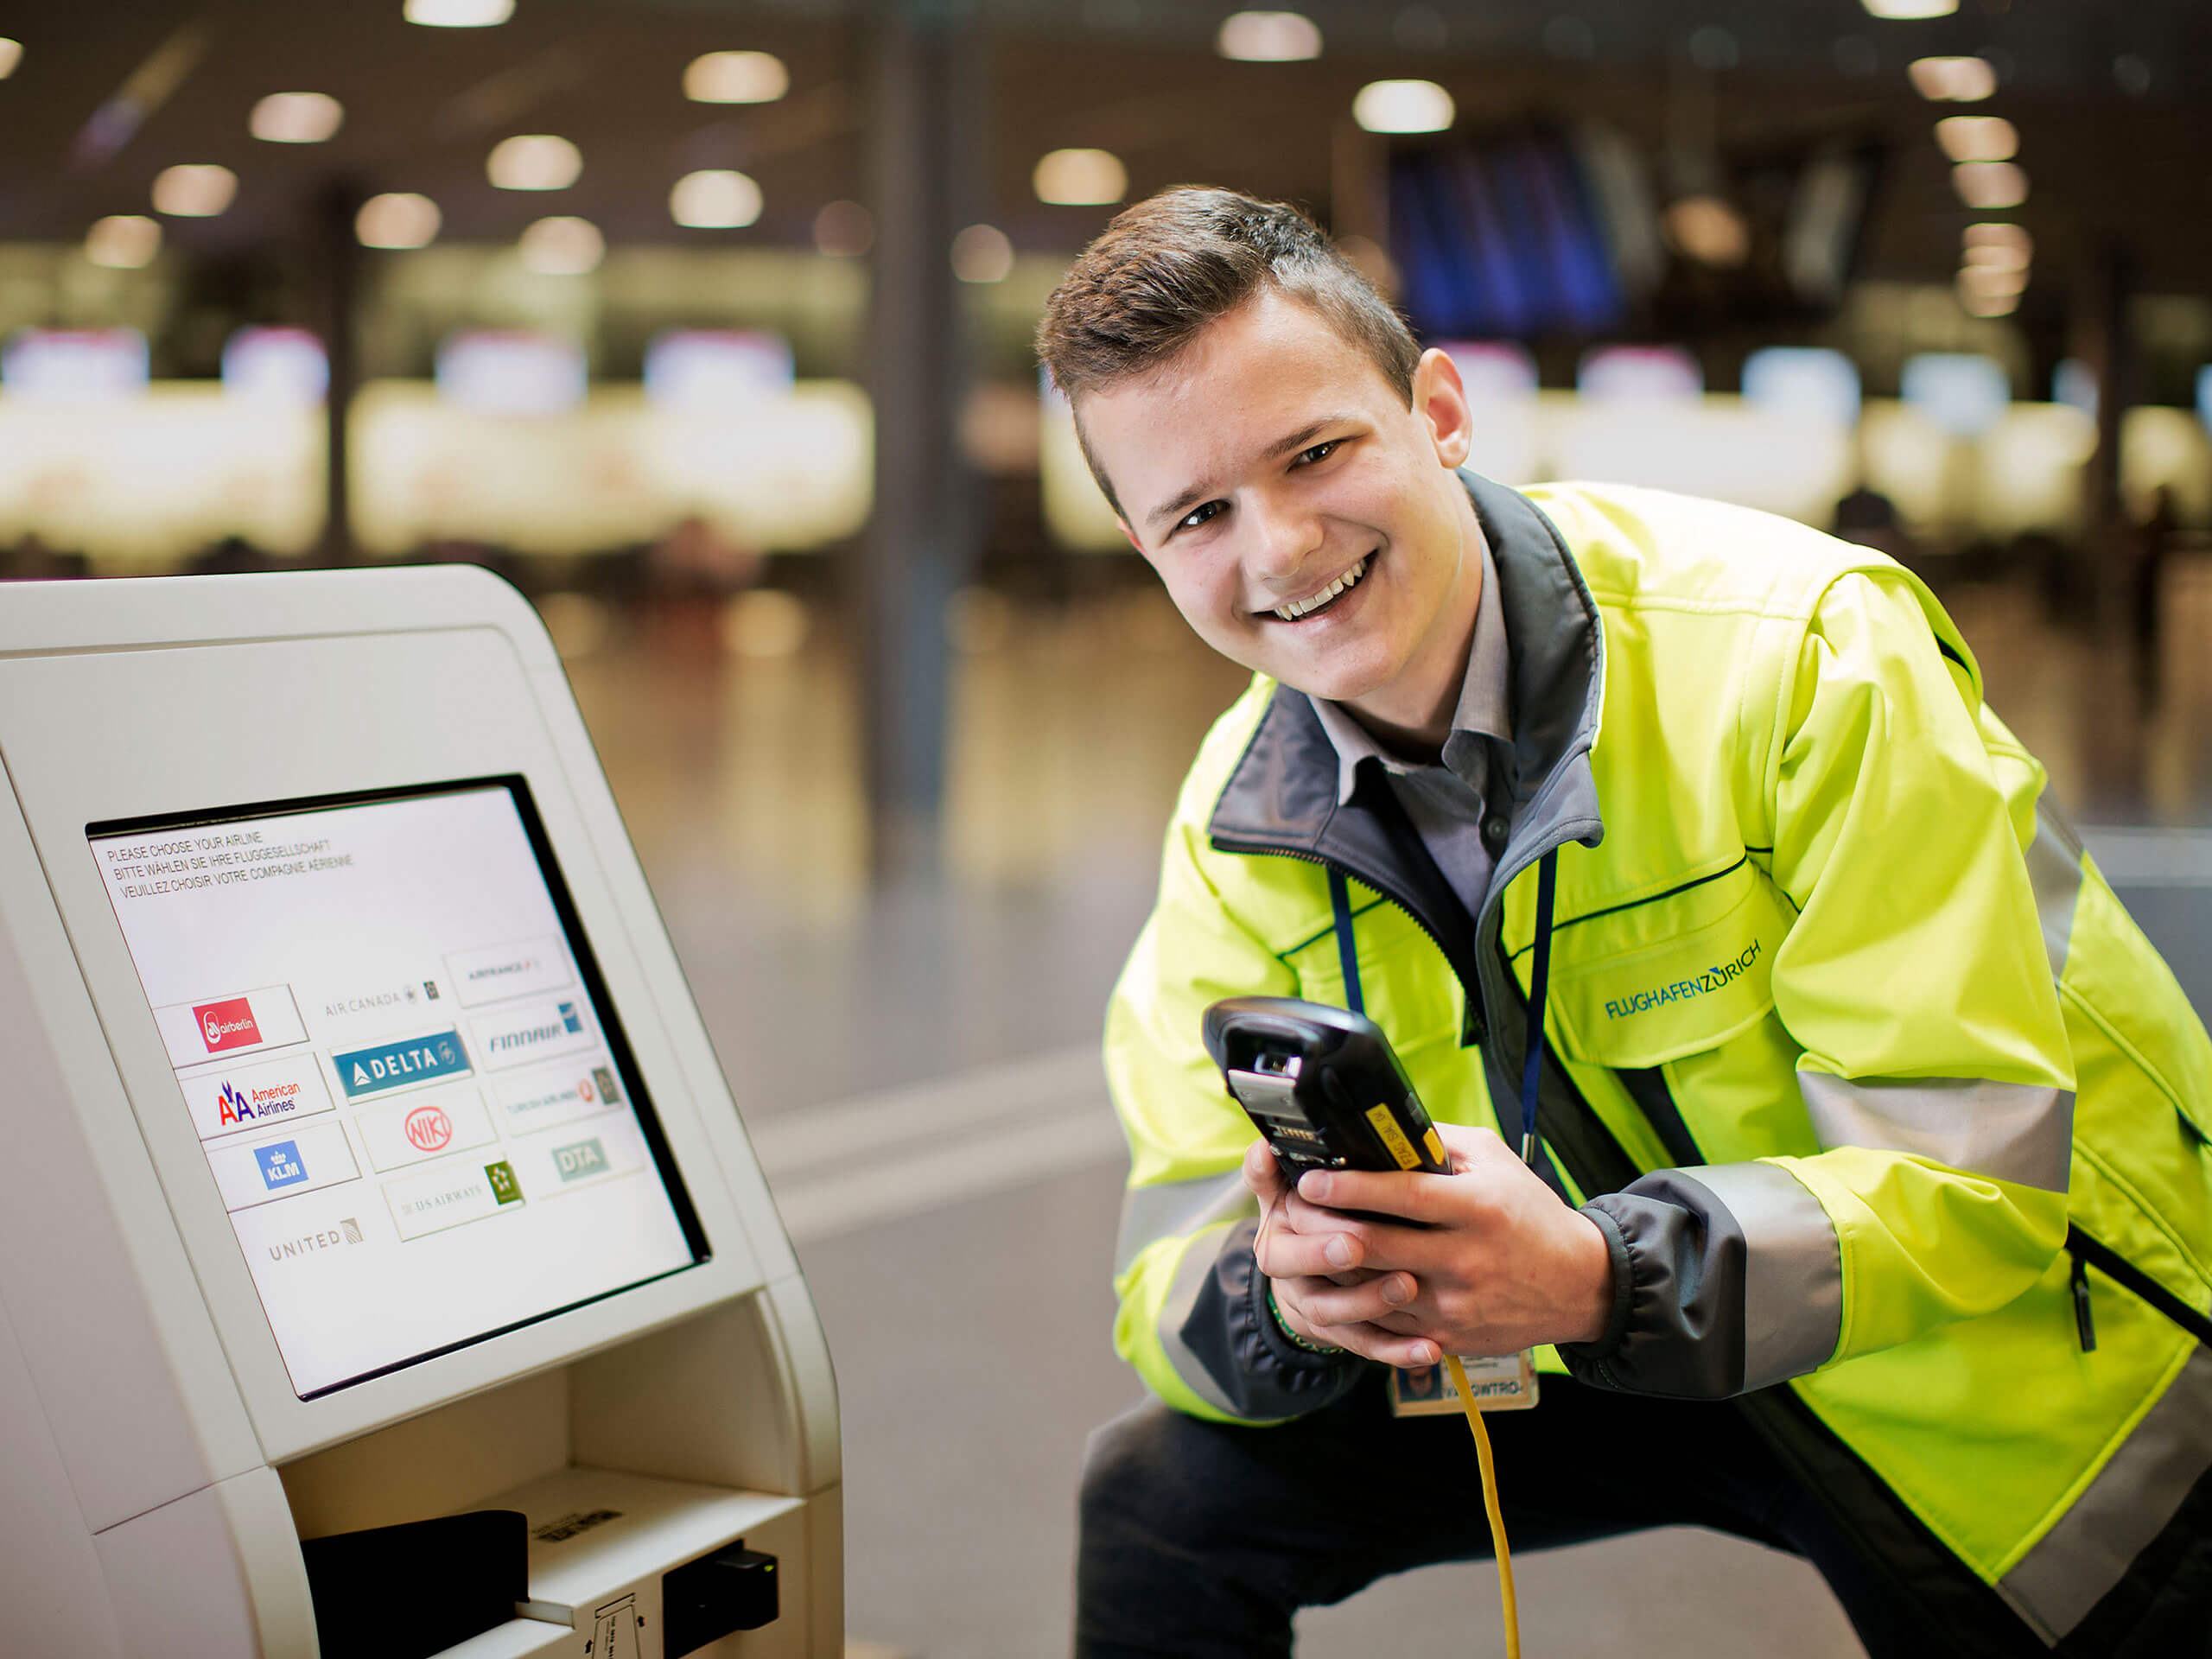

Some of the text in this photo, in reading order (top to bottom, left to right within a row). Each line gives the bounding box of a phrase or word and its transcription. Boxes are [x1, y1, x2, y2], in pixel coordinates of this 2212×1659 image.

[107, 831, 263, 862] PLEASE CHOOSE YOUR AIRLINE
[113, 865, 145, 880] BITTE
[190, 856, 208, 869] SIE
[209, 852, 234, 866] IHRE
[233, 839, 330, 863] FLUGGESELLSCHAFT
[120, 880, 171, 899] VEUILLEZ
[171, 874, 213, 892] CHOISIR
[214, 869, 249, 885] VOTRE
[251, 861, 307, 880] COMPAGNIE
[325, 992, 402, 1017] AIR CANADA
[370, 1047, 439, 1079] DELTA
[251, 1082, 302, 1103] American
[257, 1098, 296, 1118] Airlines
[410, 1114, 450, 1146] NIKI
[266, 1161, 301, 1182] KLM
[560, 1147, 599, 1173] DTA
[435, 1185, 482, 1207] AIRWAYS
[269, 1230, 340, 1262] UNITED
